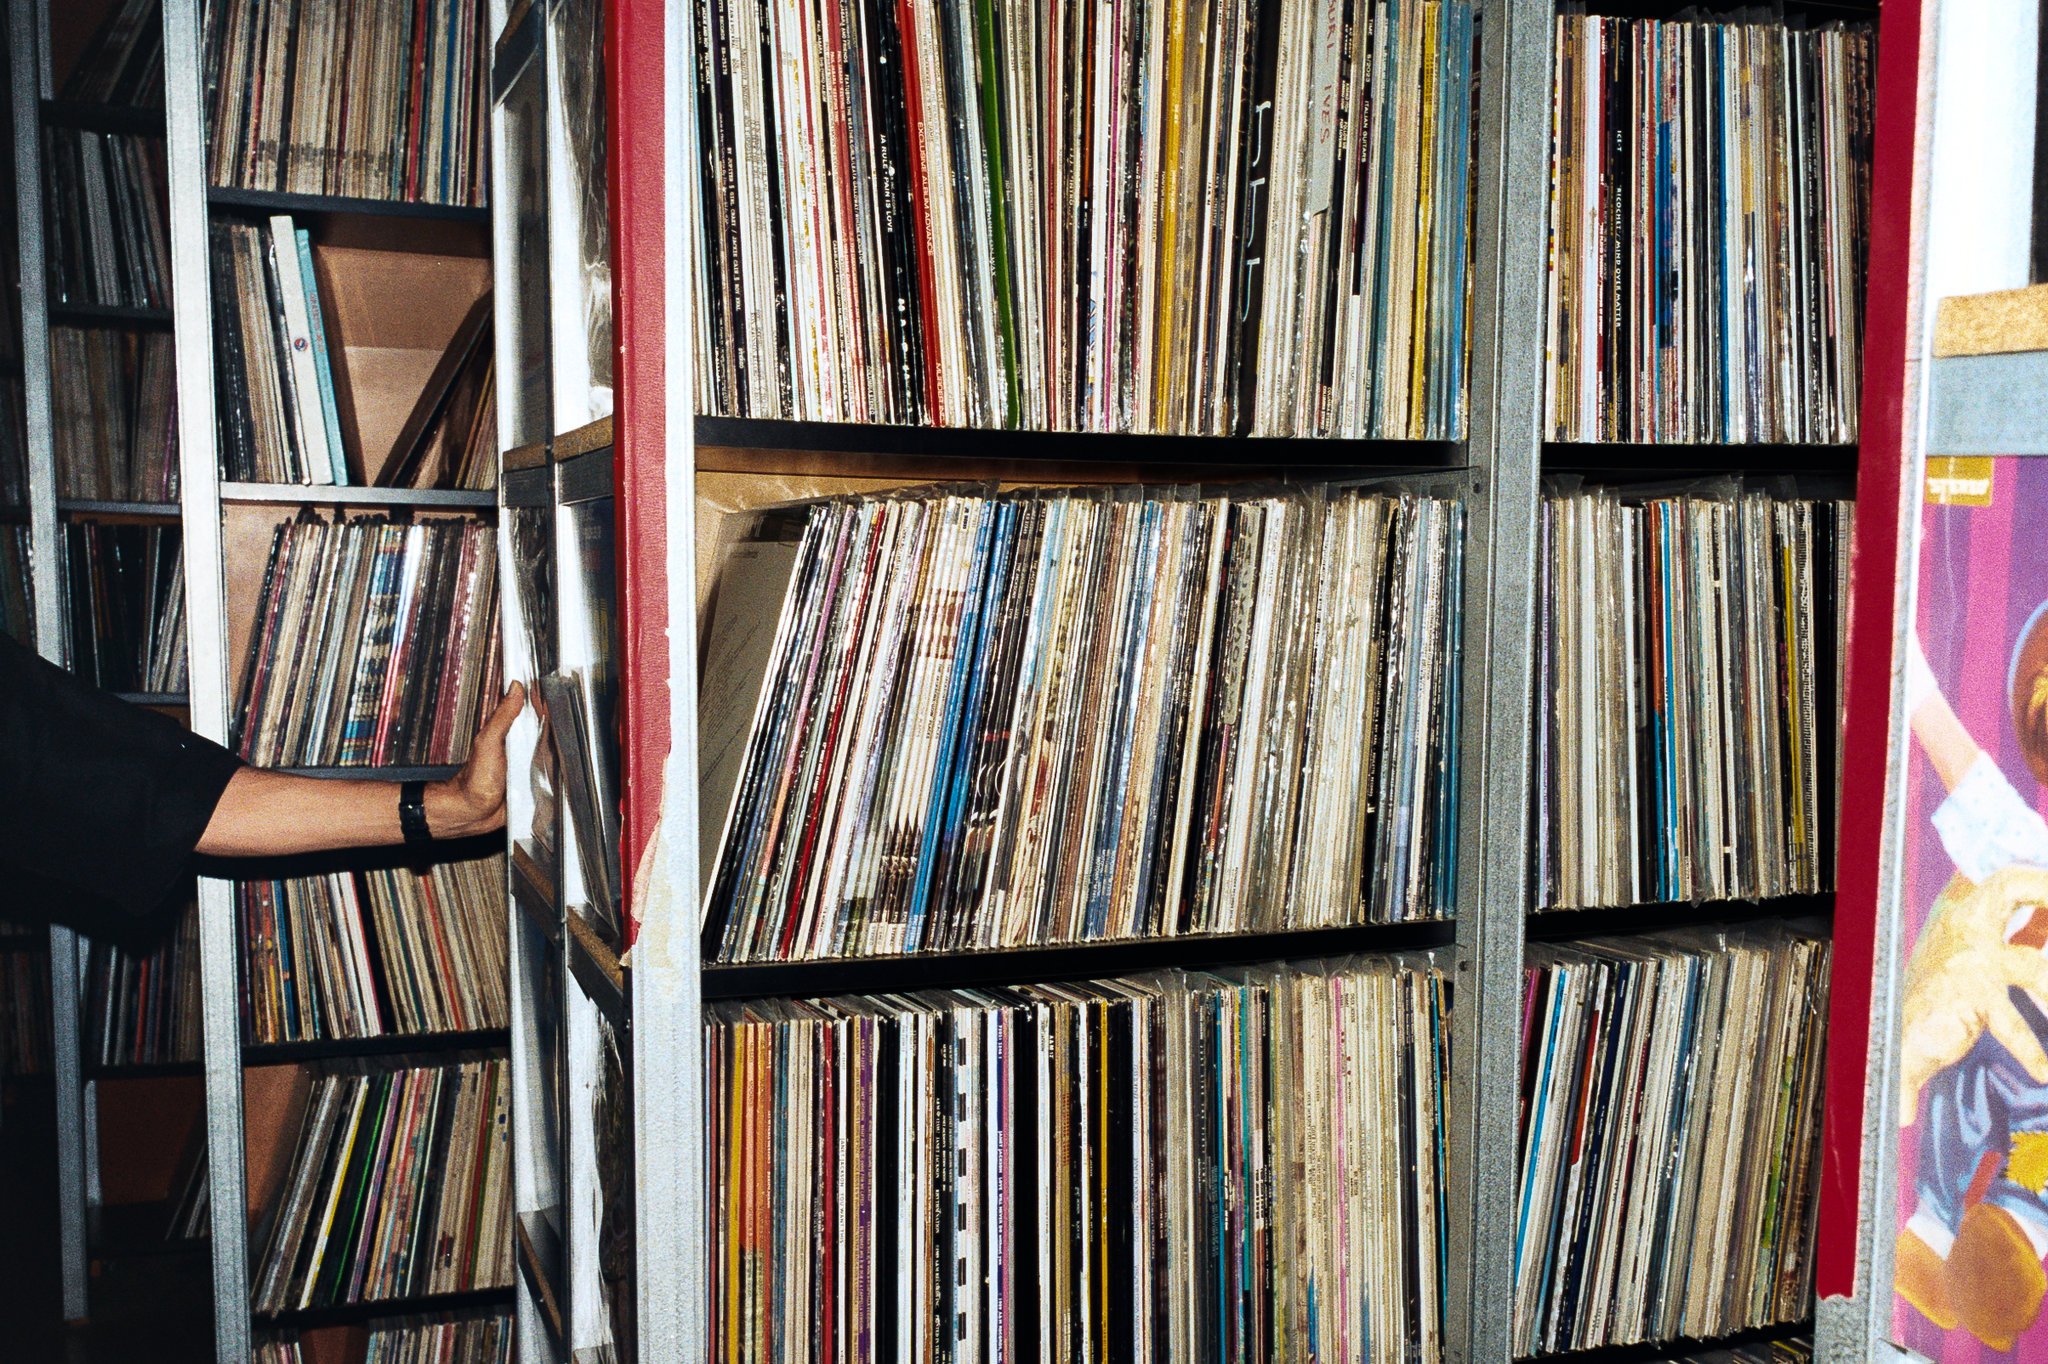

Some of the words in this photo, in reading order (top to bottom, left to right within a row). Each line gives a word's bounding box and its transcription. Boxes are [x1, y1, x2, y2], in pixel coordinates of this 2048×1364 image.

[1320, 84, 1333, 145] IVES
[917, 122, 927, 172] EXCLUSIVE
[1360, 130, 1368, 163] GUITARS
[880, 133, 886, 144] JA
[885, 199, 891, 208] IS
[921, 175, 930, 209] ALBUM
[924, 212, 934, 256] ADVANCE
[997, 1224, 1003, 1232] DO
